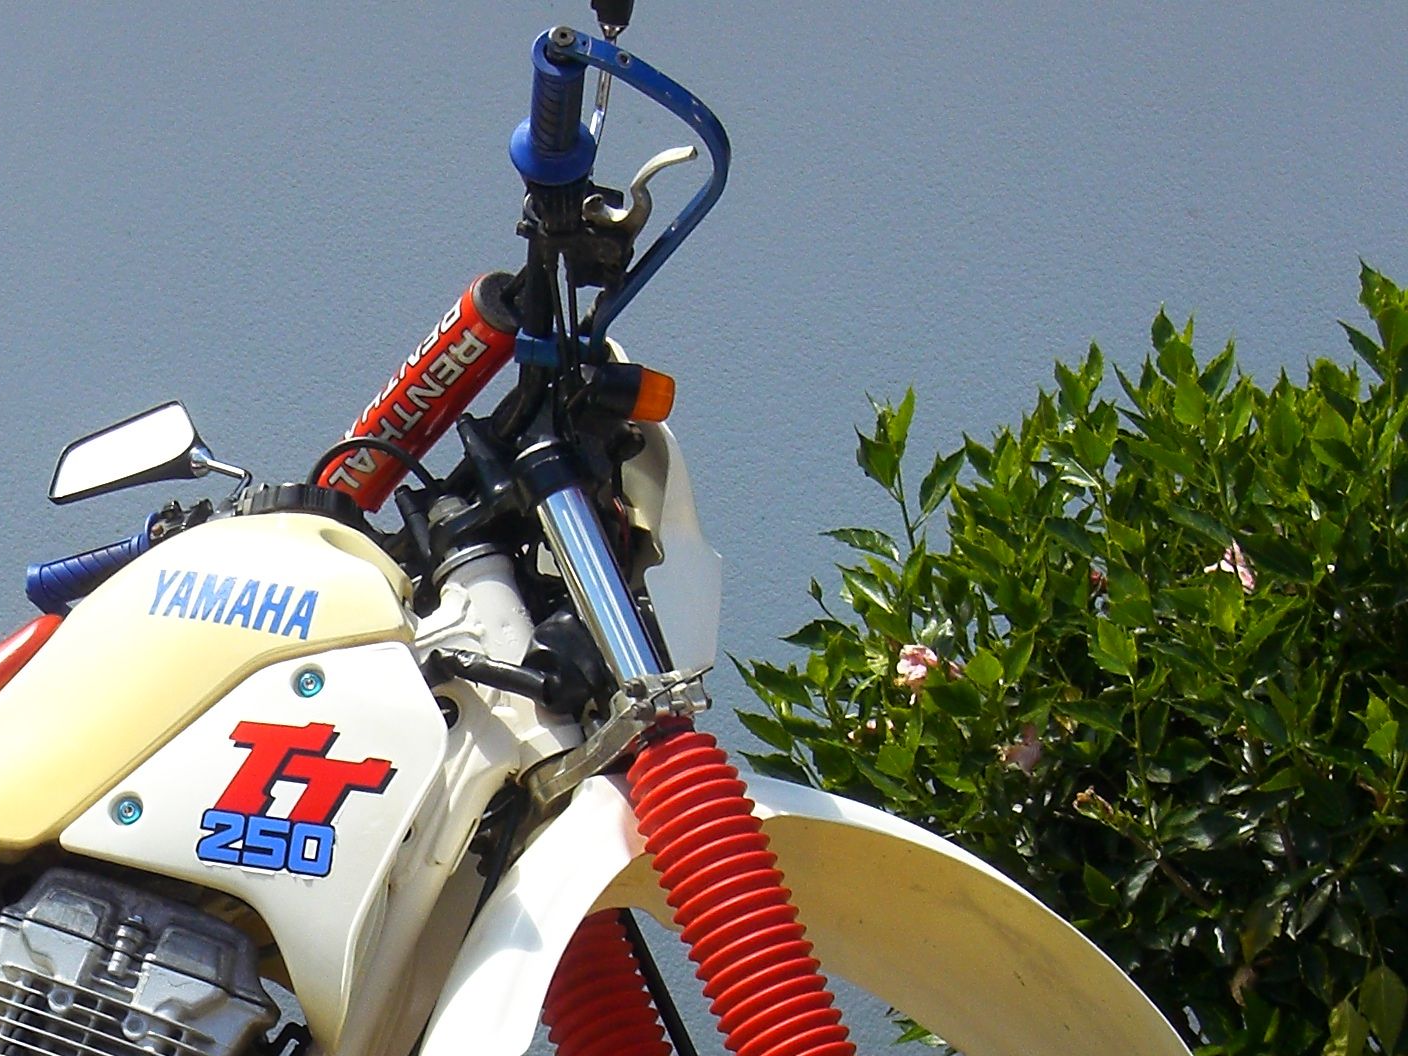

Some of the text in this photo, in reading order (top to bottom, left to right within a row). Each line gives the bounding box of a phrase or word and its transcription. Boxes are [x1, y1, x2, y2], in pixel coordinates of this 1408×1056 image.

[329, 328, 489, 489] RENTHAL
[148, 569, 319, 640] YAMAHA
[213, 720, 398, 826] TT
[195, 808, 335, 878] 250
